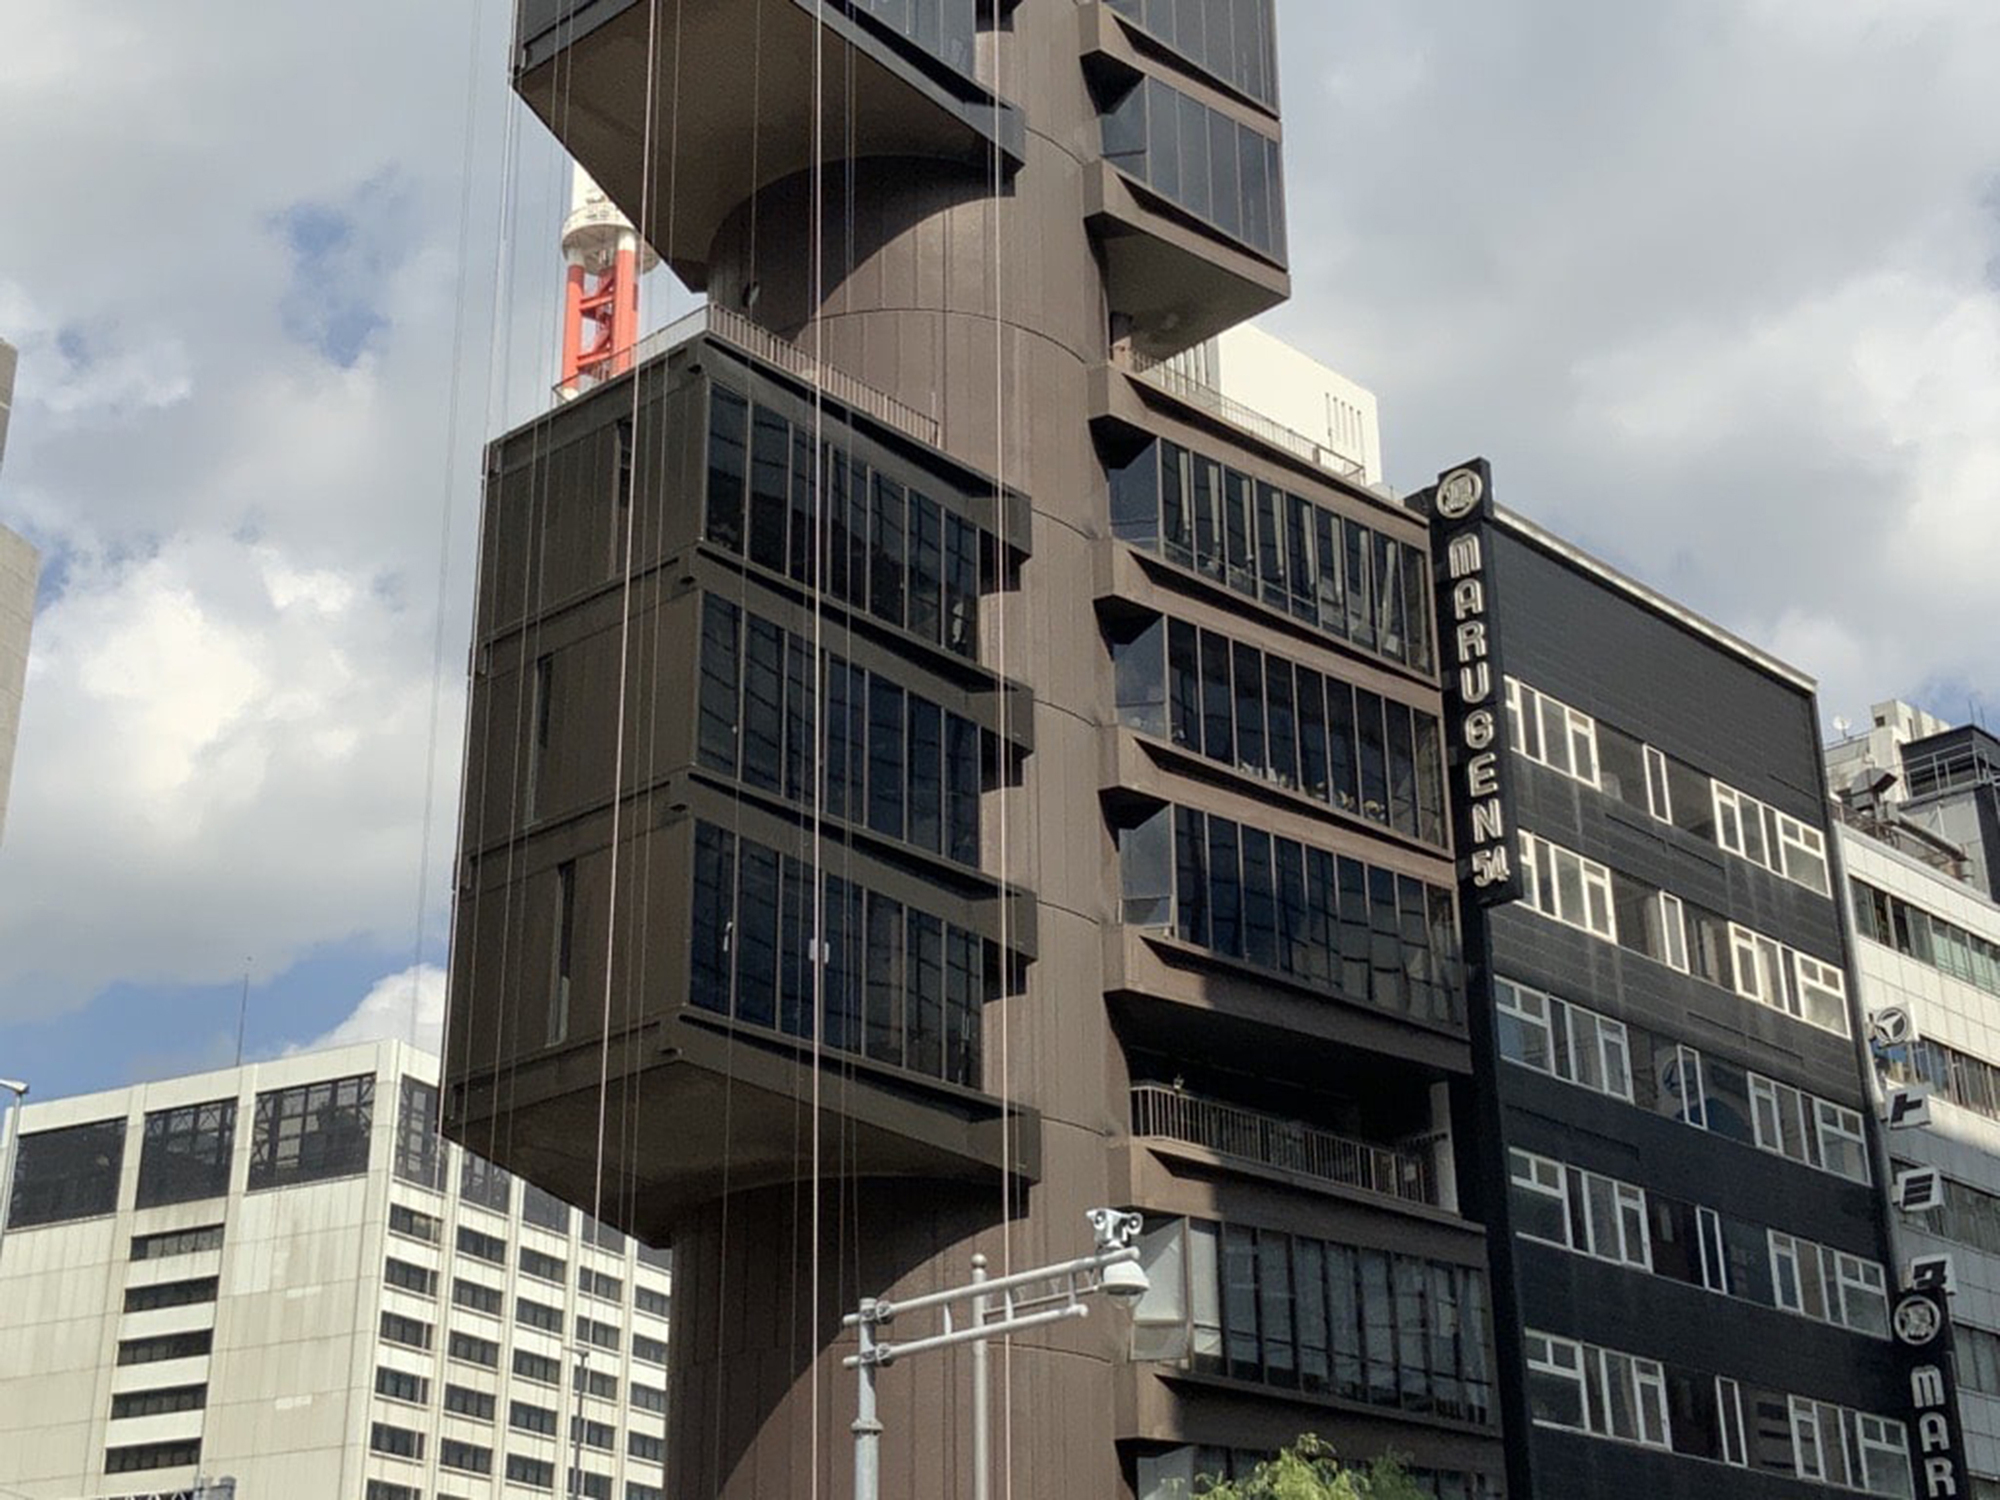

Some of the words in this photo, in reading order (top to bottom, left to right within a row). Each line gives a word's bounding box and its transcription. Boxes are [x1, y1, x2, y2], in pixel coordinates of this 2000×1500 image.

[1448, 532, 1503, 843] MARUGEN
[1472, 845, 1511, 888] 54
[1910, 1364, 1957, 1498] MAR
